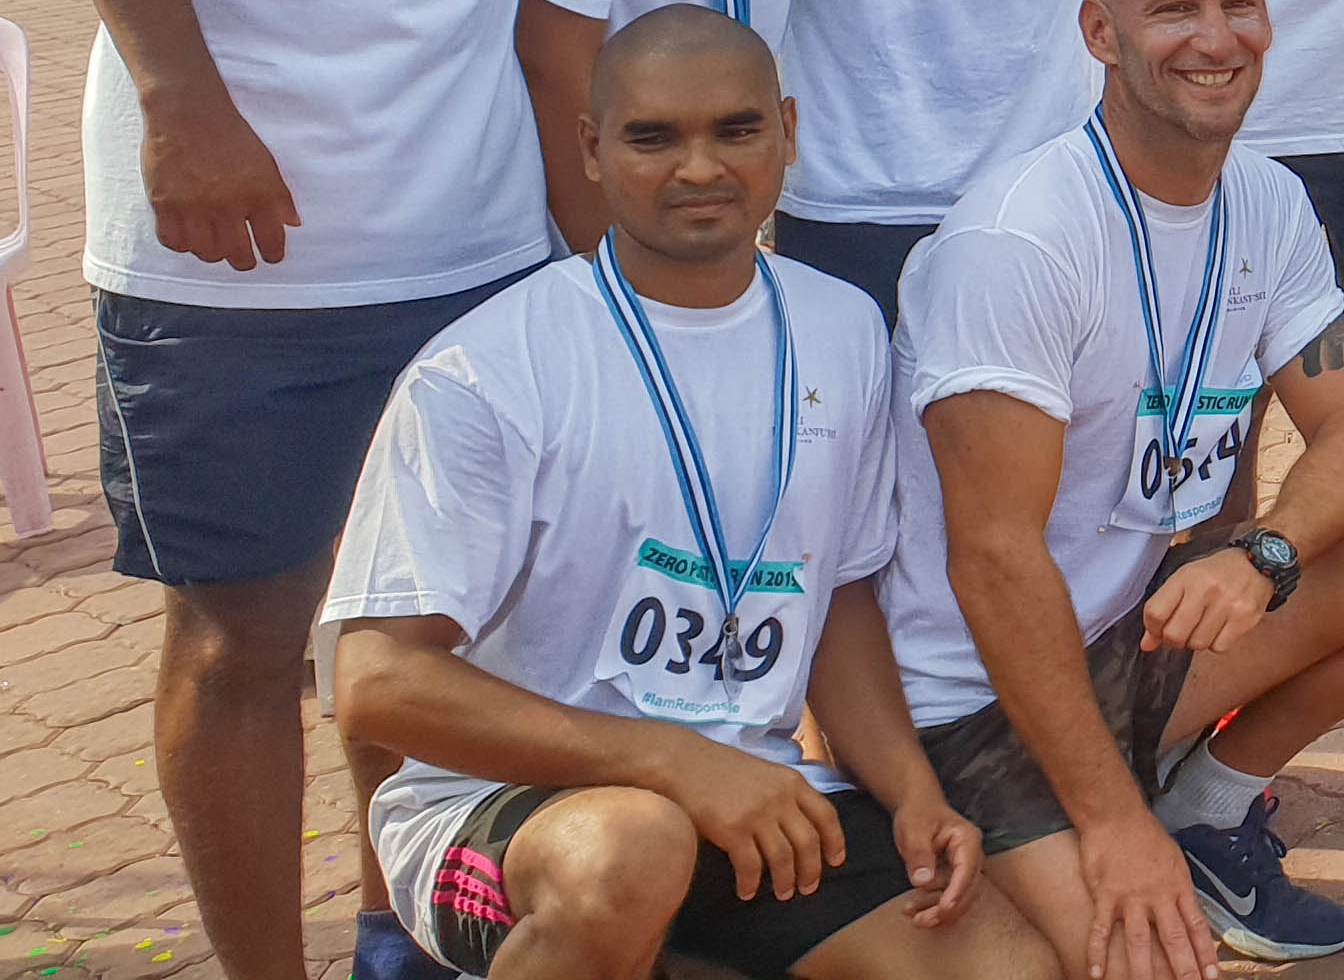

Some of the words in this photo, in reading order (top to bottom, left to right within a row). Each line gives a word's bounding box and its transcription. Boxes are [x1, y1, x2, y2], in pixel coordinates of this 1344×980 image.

[643, 547, 688, 575] ZERO
[731, 567, 764, 586] RN
[620, 596, 784, 683] 0349
